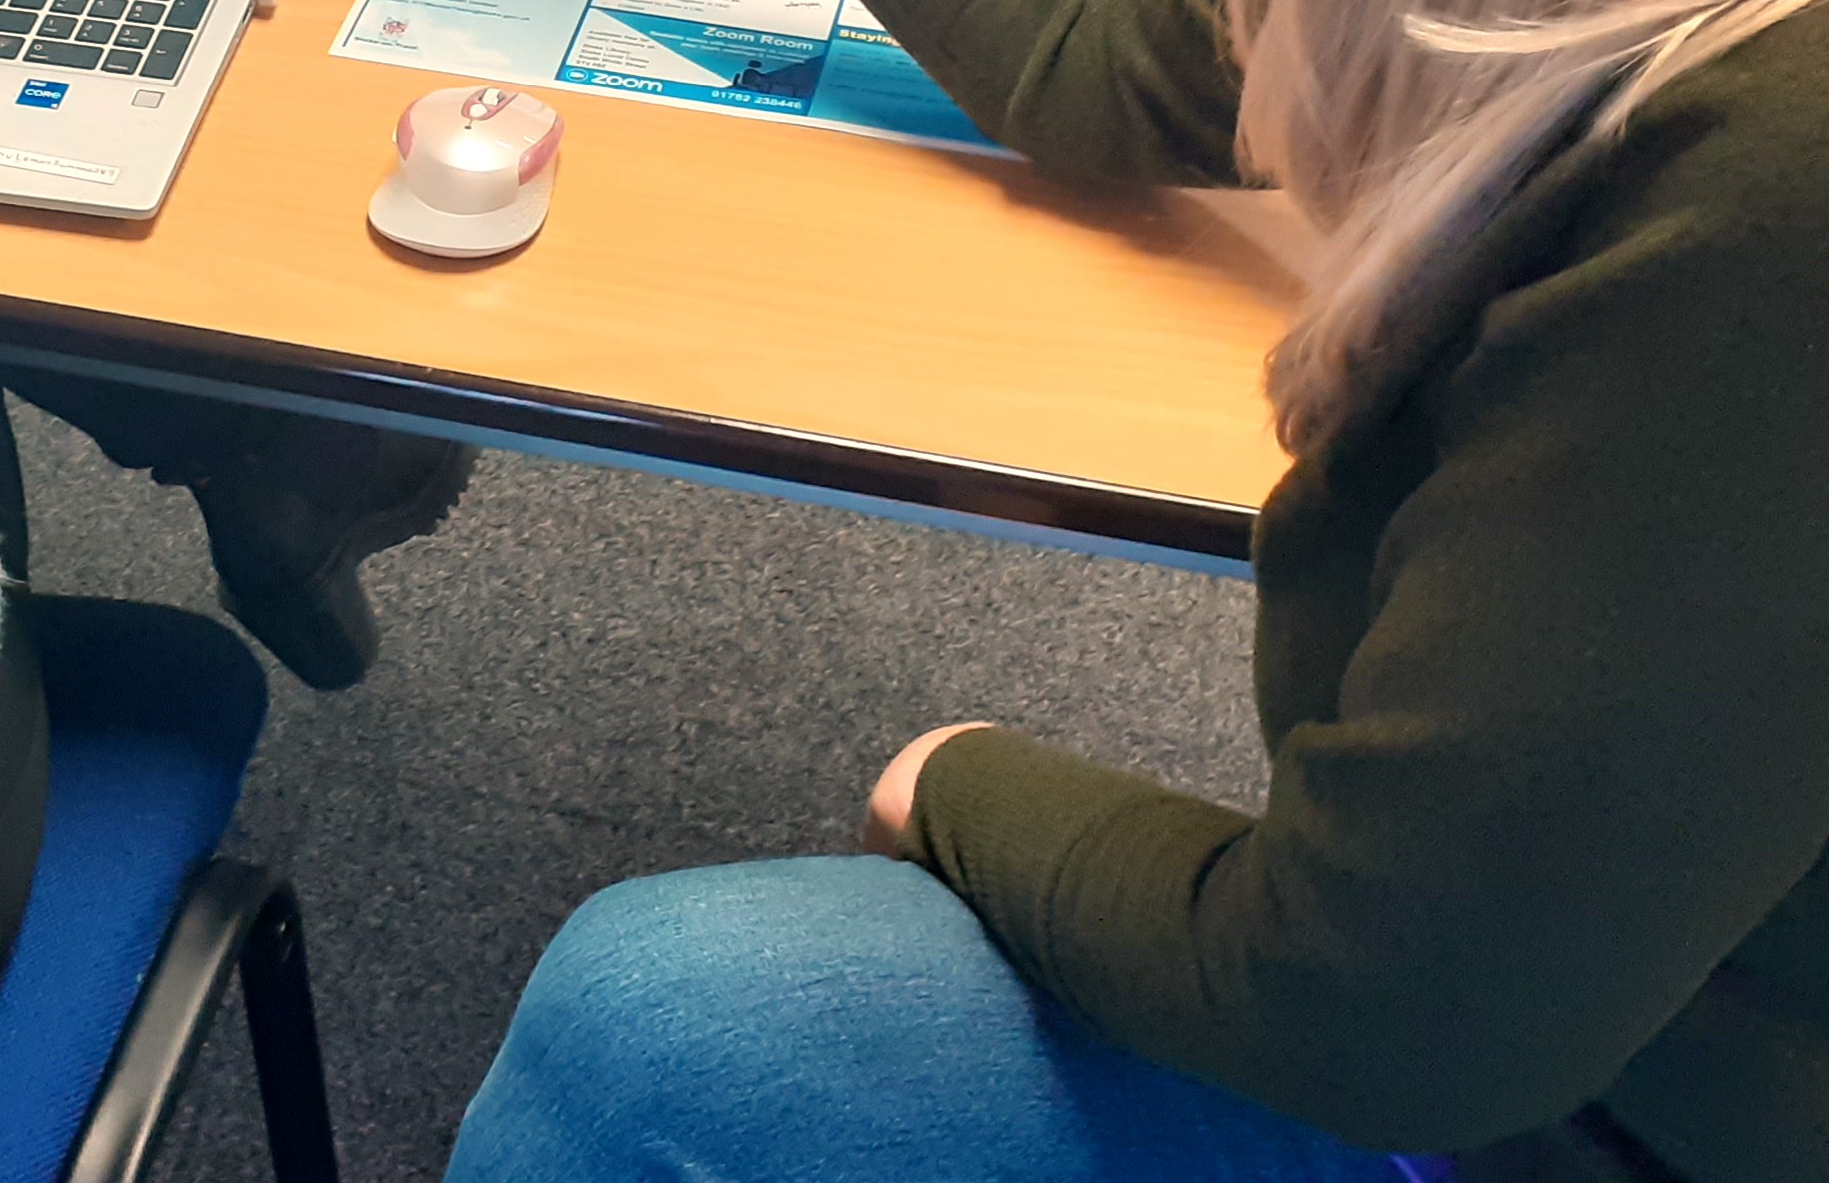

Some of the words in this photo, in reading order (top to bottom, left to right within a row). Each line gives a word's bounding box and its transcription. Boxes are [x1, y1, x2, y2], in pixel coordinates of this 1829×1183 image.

[702, 26, 755, 44] Zoom
[759, 33, 814, 52] Room
[590, 71, 664, 94] zoom
[711, 89, 752, 102] 01782
